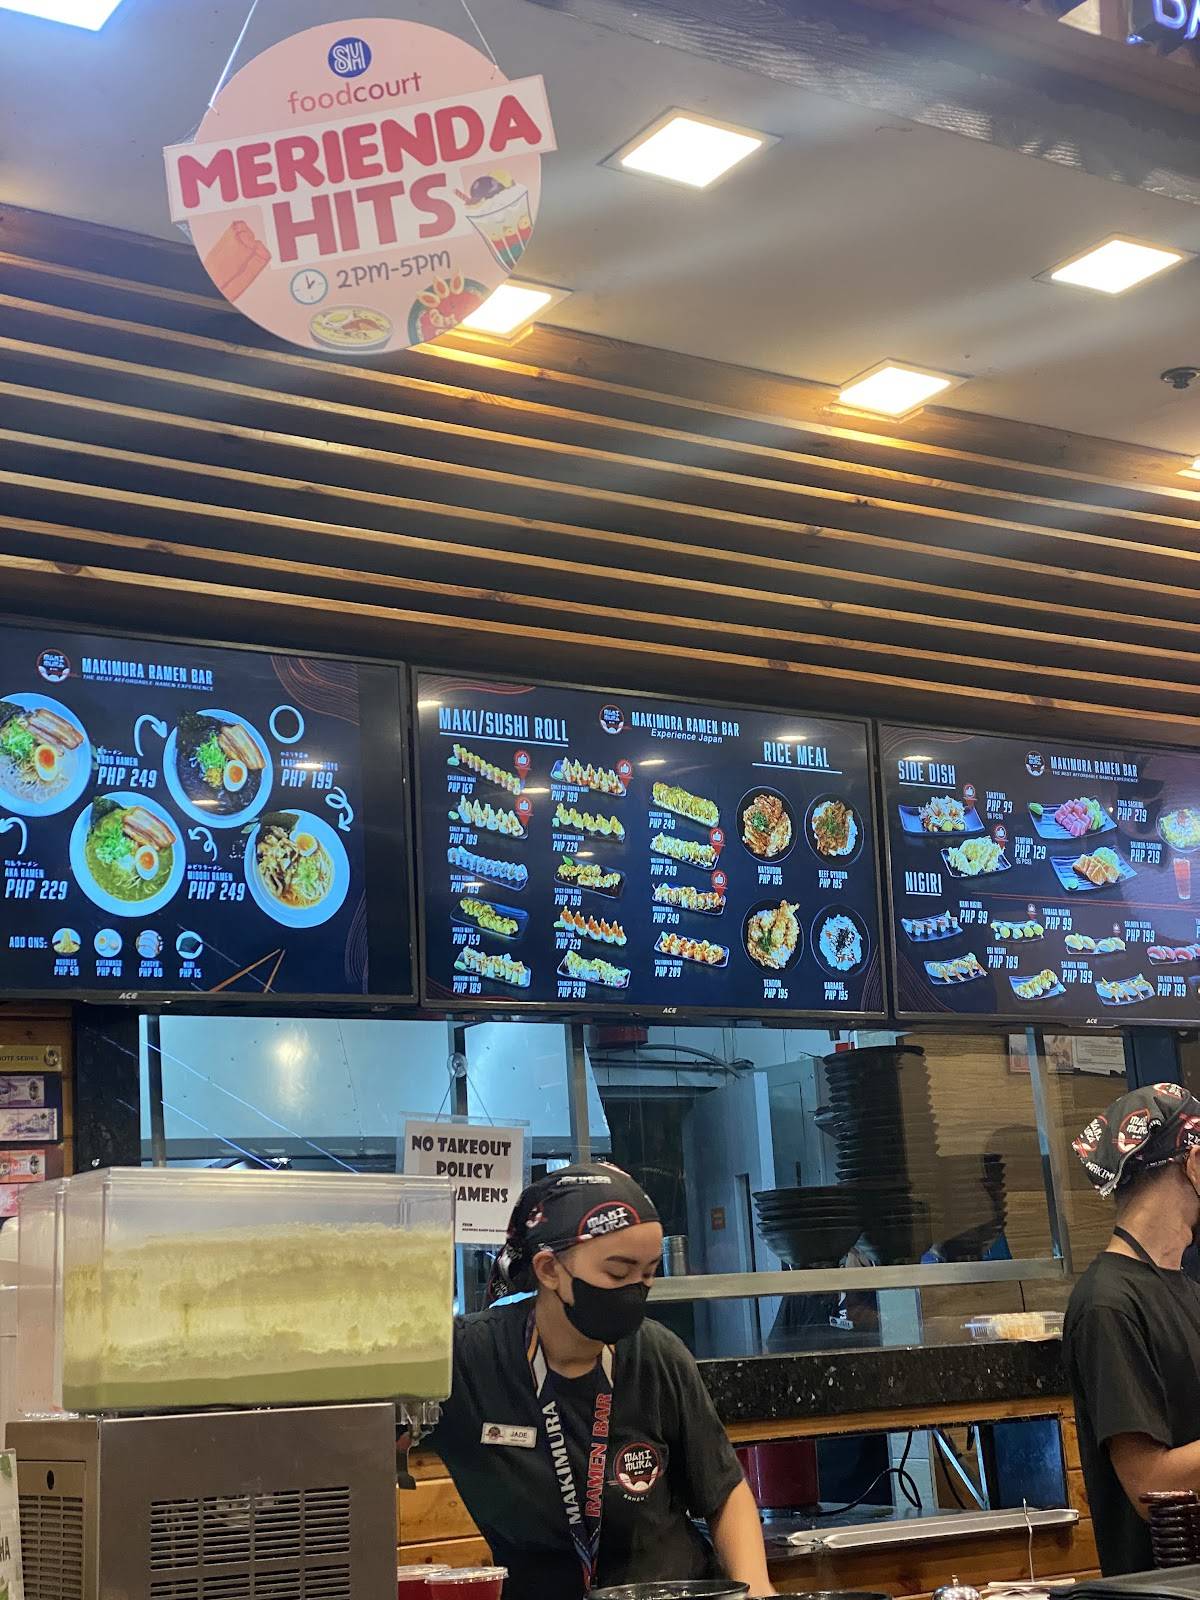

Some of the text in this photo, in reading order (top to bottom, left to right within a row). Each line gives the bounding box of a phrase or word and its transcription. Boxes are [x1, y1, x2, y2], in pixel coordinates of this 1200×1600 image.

[288, 72, 422, 114] foodcourt
[177, 95, 542, 209] MERIENDA
[272, 173, 456, 263] HITS
[82, 658, 144, 678] MAKIMURA
[149, 665, 187, 682] RAMEN
[191, 668, 213, 685] BAR
[439, 707, 569, 742] MAKI/SUSHI ROLL
[631, 711, 683, 731] MAKIMURA
[687, 718, 718, 735] RAMEN
[722, 721, 739, 737] BAR
[651, 728, 723, 744] Experience Japan
[763, 741, 830, 768] RICE MEAL
[898, 760, 956, 785] SIDE DISH
[1051, 756, 1092, 773] MAKIMURA
[1094, 760, 1120, 775] RAMEN
[1123, 763, 1138, 777] BAR
[98, 766, 157, 788] PHP 249
[281, 769, 333, 789] PHP 199
[448, 781, 461, 793] PHP
[551, 791, 564, 801] PHP
[986, 799, 1013, 813] PHP 99
[1117, 807, 1147, 822] PHP 219
[649, 818, 676, 830] PHP 249
[449, 833, 464, 844] PHP
[553, 840, 578, 853] PHP 229
[1015, 844, 1047, 859] PHP 129
[1131, 849, 1160, 864] PHP 219
[650, 864, 663, 875] PHP
[759, 874, 783, 885] PHP 195
[819, 878, 831, 888] PHP
[905, 871, 942, 894] NIGIRI
[5, 879, 68, 900] PHP 229
[188, 881, 246, 901] PHP 249
[451, 881, 465, 893] PHP
[554, 894, 582, 906] PHP 199
[653, 912, 680, 924] PHP 249
[960, 909, 988, 924] PHP 99
[1045, 916, 1073, 931] PHP 99
[453, 933, 480, 945] PHP 159
[1126, 929, 1155, 943] PHP 199
[556, 938, 582, 950] PHP 229
[988, 955, 1019, 969] PHP 189
[54, 965, 68, 976] PHP
[96, 966, 110, 977] PHP
[139, 967, 152, 977] PHP
[179, 968, 193, 978] PHP
[655, 966, 667, 977] PHP
[1063, 969, 1093, 983] PHP 199
[453, 982, 467, 993] PHP
[558, 986, 586, 998] PHP 249
[764, 988, 788, 999] PHP 195
[1158, 983, 1186, 997] PHP 199
[824, 990, 848, 1000] PHP 195
[412, 1135, 512, 1157] NO TAKEOUT
[436, 1161, 494, 1179] POLICY
[455, 1186, 509, 1204] AMENS
[542, 1400, 584, 1525] MAKIMURA
[585, 1393, 613, 1518] RAMEN BAR
[624, 1450, 652, 1462] MAKI
[625, 1460, 652, 1471] MURA
